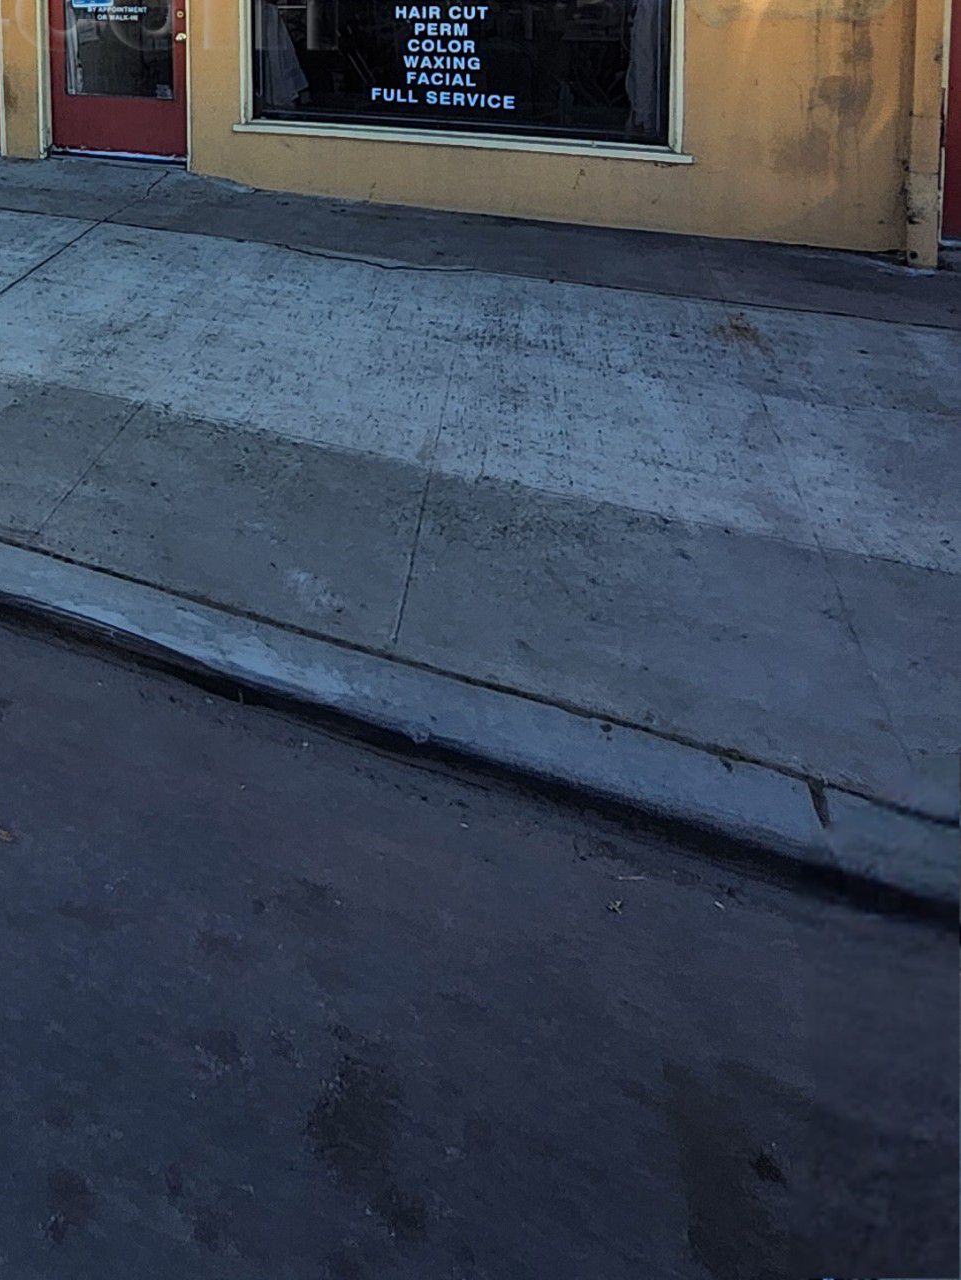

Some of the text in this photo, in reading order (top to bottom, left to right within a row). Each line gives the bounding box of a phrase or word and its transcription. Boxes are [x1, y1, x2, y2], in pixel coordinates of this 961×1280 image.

[98, 6, 148, 14] APPOINTMENT
[395, 5, 489, 20] HAIR CUT
[414, 22, 469, 37] PERM
[407, 38, 476, 53] COLOR
[403, 55, 481, 71] WAXING
[406, 71, 477, 87] FACIAL
[371, 87, 516, 110] FULL SERVICE
